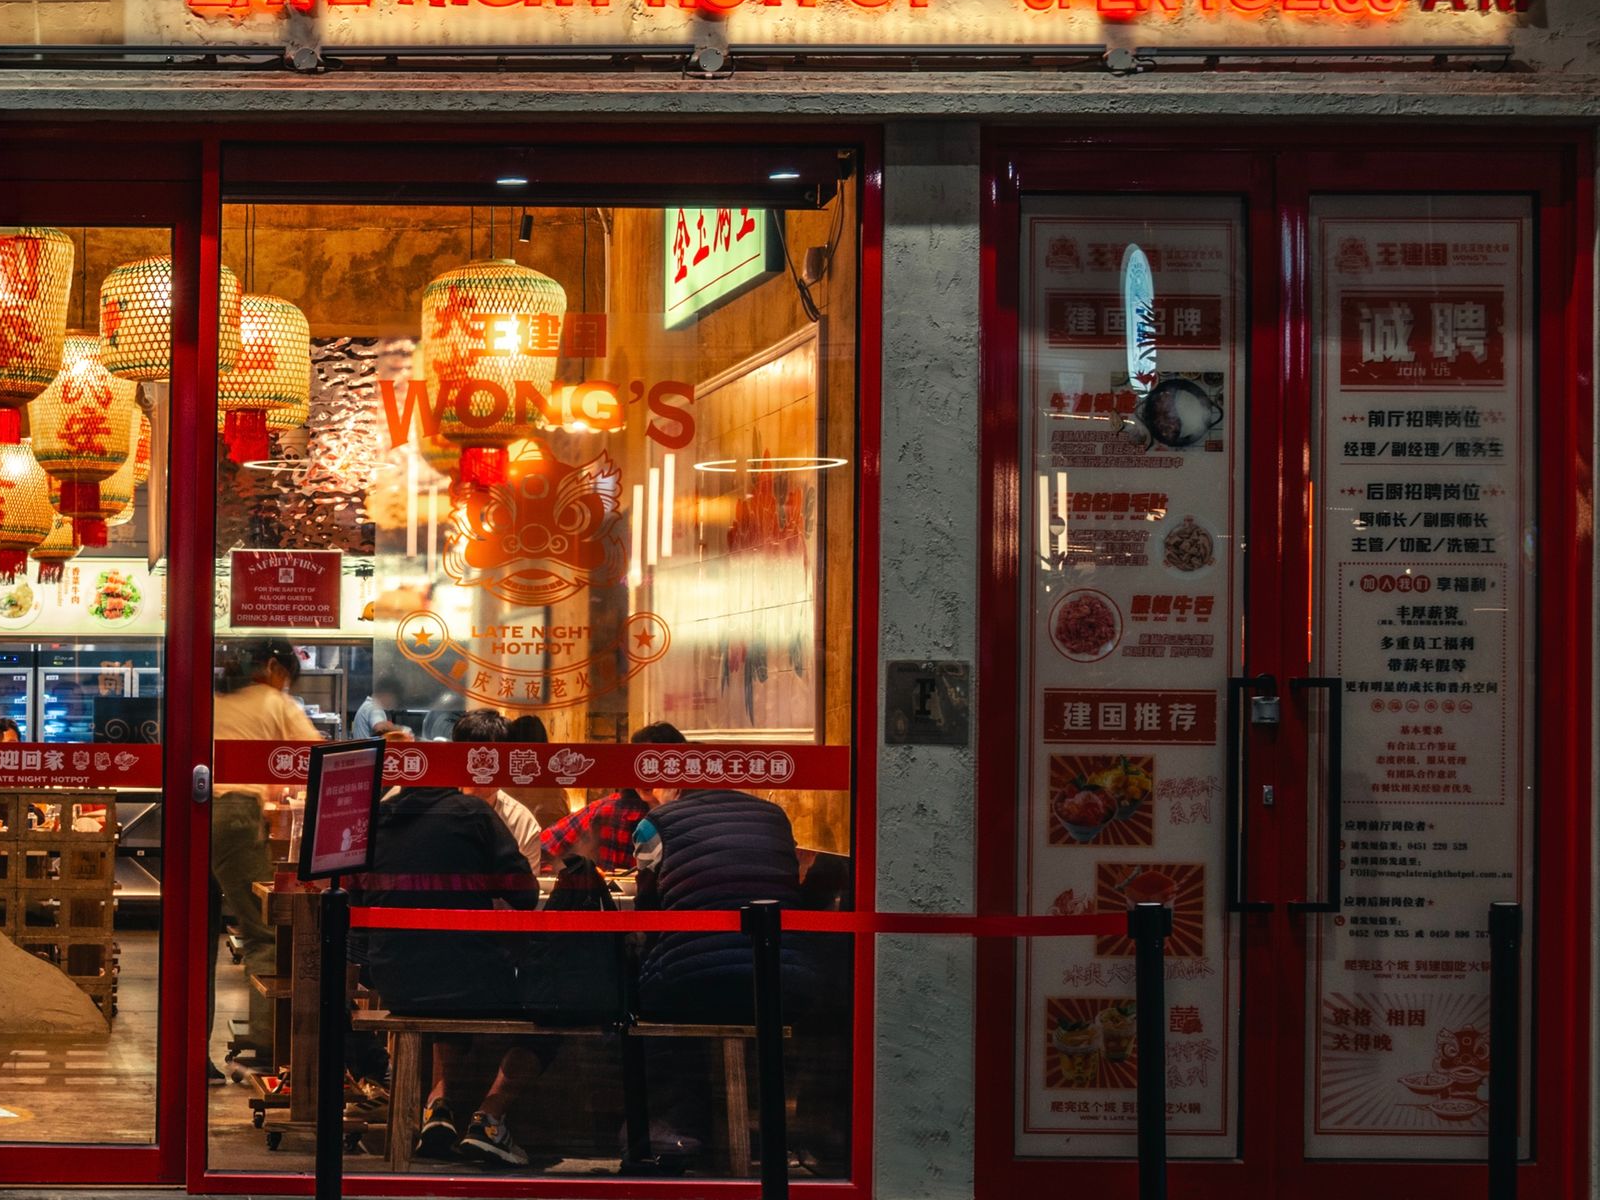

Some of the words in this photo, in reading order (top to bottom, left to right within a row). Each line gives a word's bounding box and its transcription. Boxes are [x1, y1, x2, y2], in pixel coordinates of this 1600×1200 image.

[1376, 243, 1447, 266] 王建国
[470, 312, 607, 358] 王建国
[1357, 301, 1489, 365] 诚聘
[1397, 366, 1426, 377] JOIN
[1434, 366, 1451, 377] US
[378, 380, 695, 450] WONG'S
[1367, 409, 1481, 428] 前厅招聘岗位
[1366, 482, 1481, 502] 后厨招聘岗位
[248, 557, 290, 574] SAFETY
[292, 557, 326, 575] FIRST
[1361, 575, 1430, 592] 加入我们
[1436, 577, 1487, 592] 享福利
[256, 603, 290, 611] OUTSIDE
[317, 604, 330, 612] OR
[1396, 605, 1460, 620] 丰厚薪资
[288, 615, 334, 623] PERMITTED
[471, 626, 524, 639] LATE
[492, 642, 575, 656] HOTPOT
[1380, 636, 1475, 651] 多重员工福利
[1387, 658, 1467, 673] 带薪年假等
[1345, 681, 1498, 694] 更有明显的成长和晋升空间
[1063, 702, 1197, 732] 建国推荐
[640, 757, 788, 777] 独恋墨城王建国
[17, 775, 48, 783] NIGHT
[51, 776, 90, 784] HOTPOT
[1344, 820, 1426, 831] 应聘前厅岗位者
[1344, 896, 1425, 908] 应聘后厨岗位者
[1332, 1009, 1372, 1027] 资格
[1386, 1009, 1427, 1027] 相因
[1332, 1033, 1394, 1052] 关得晚
[1122, 1101, 1201, 1114] 到吃火锅
